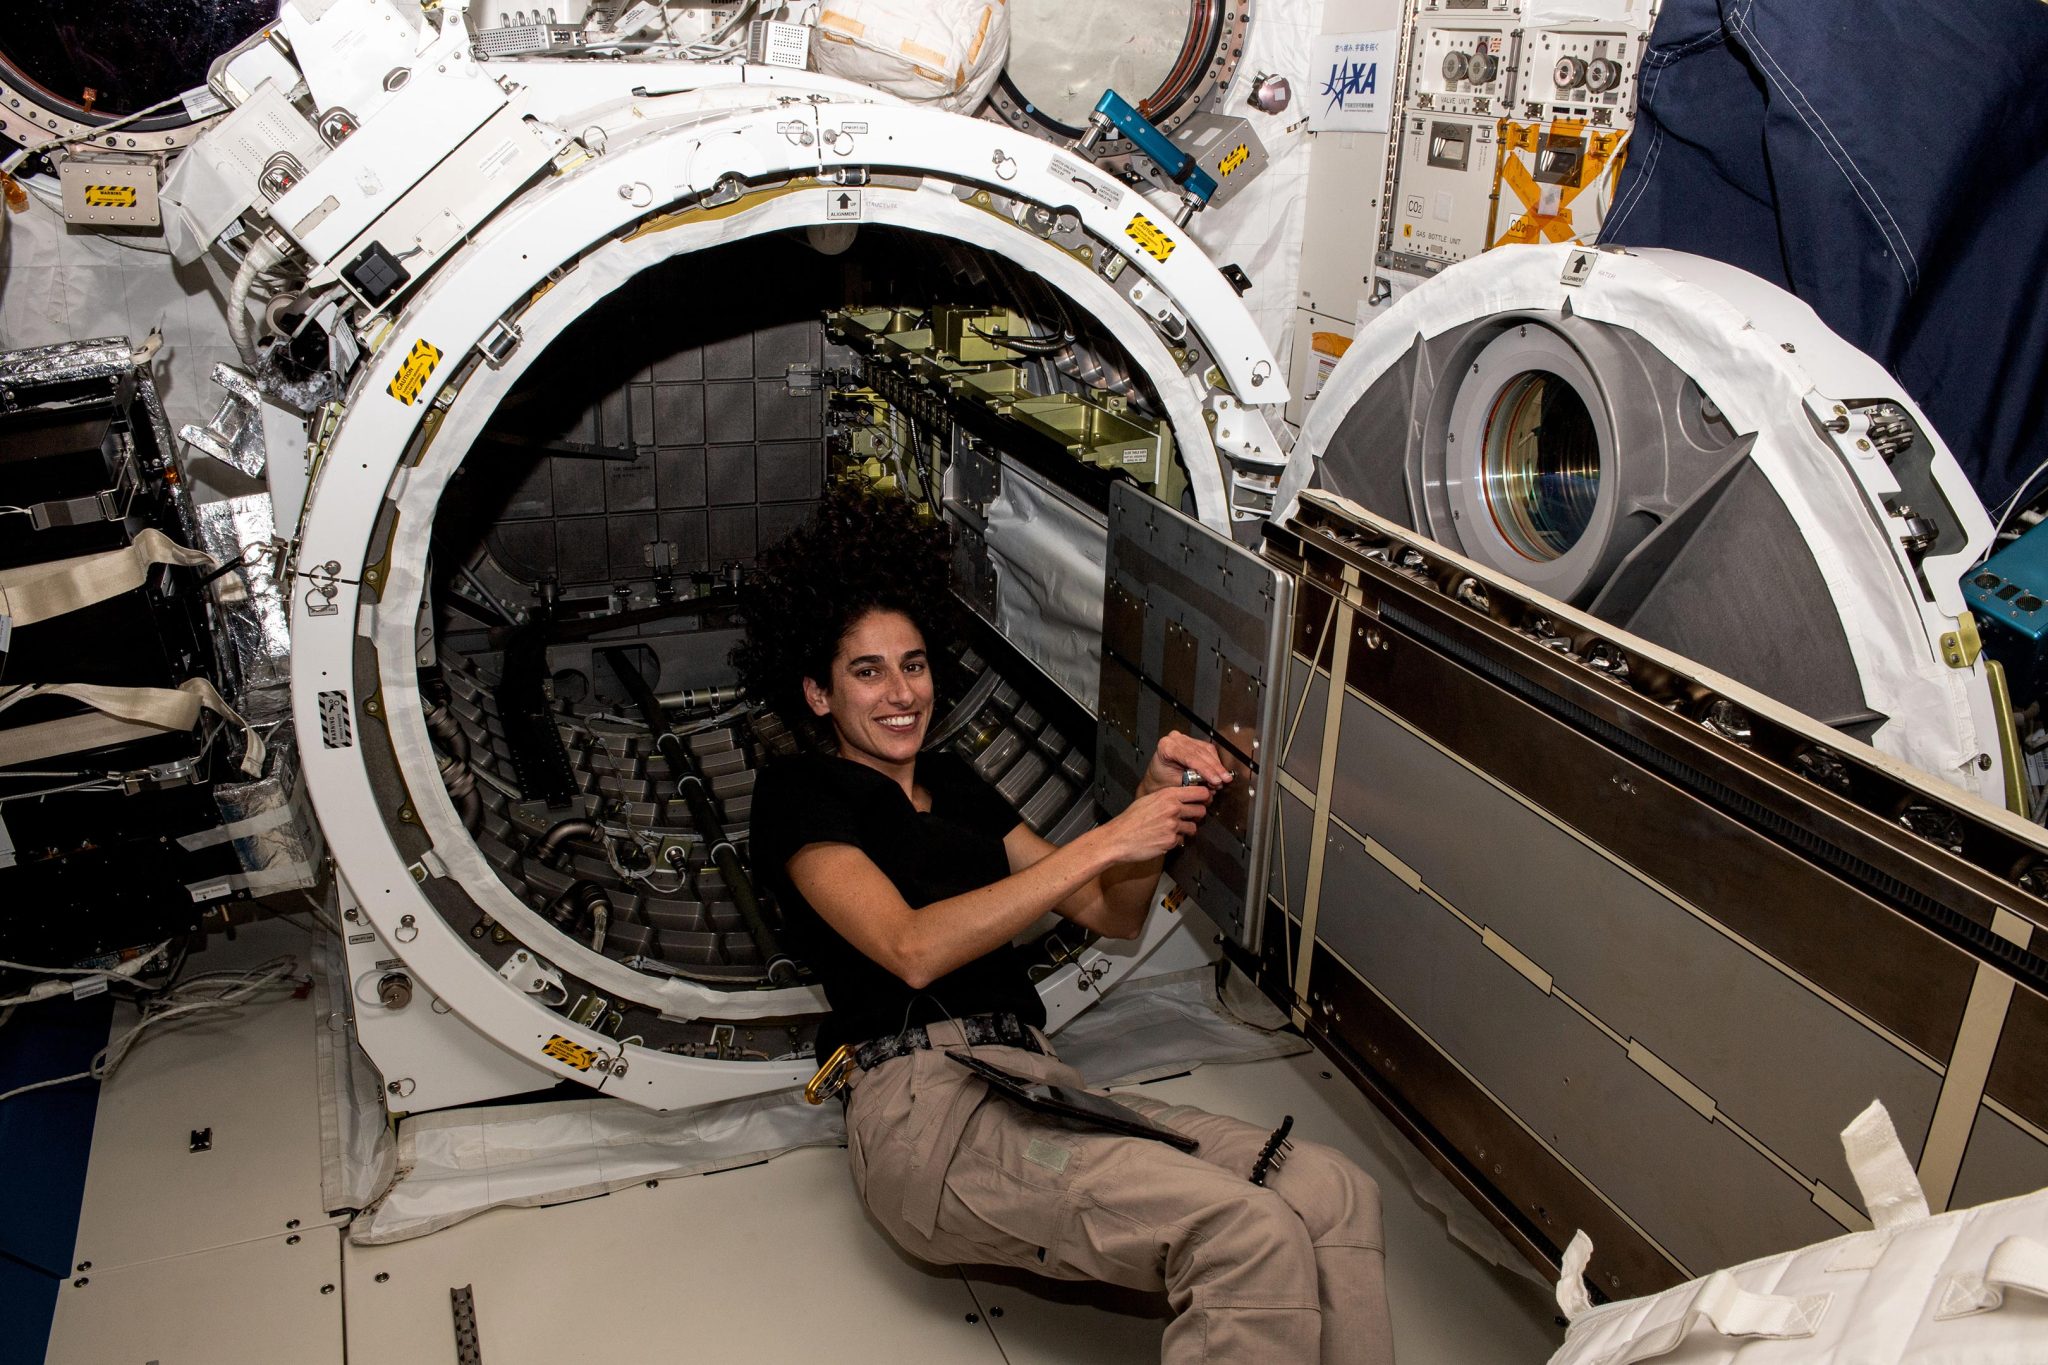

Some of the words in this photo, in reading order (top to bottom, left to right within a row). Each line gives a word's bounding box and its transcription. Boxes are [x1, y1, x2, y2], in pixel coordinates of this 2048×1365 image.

[1320, 57, 1377, 111] JAXA
[1137, 221, 1155, 237] CAUTION
[1416, 230, 1426, 238] GAS
[1428, 232, 1447, 243] BOTTLE
[1449, 237, 1461, 245] UNIT
[396, 367, 414, 391] CAUTION
[329, 716, 337, 741] WARNING
[555, 1041, 575, 1053] CAUTION
